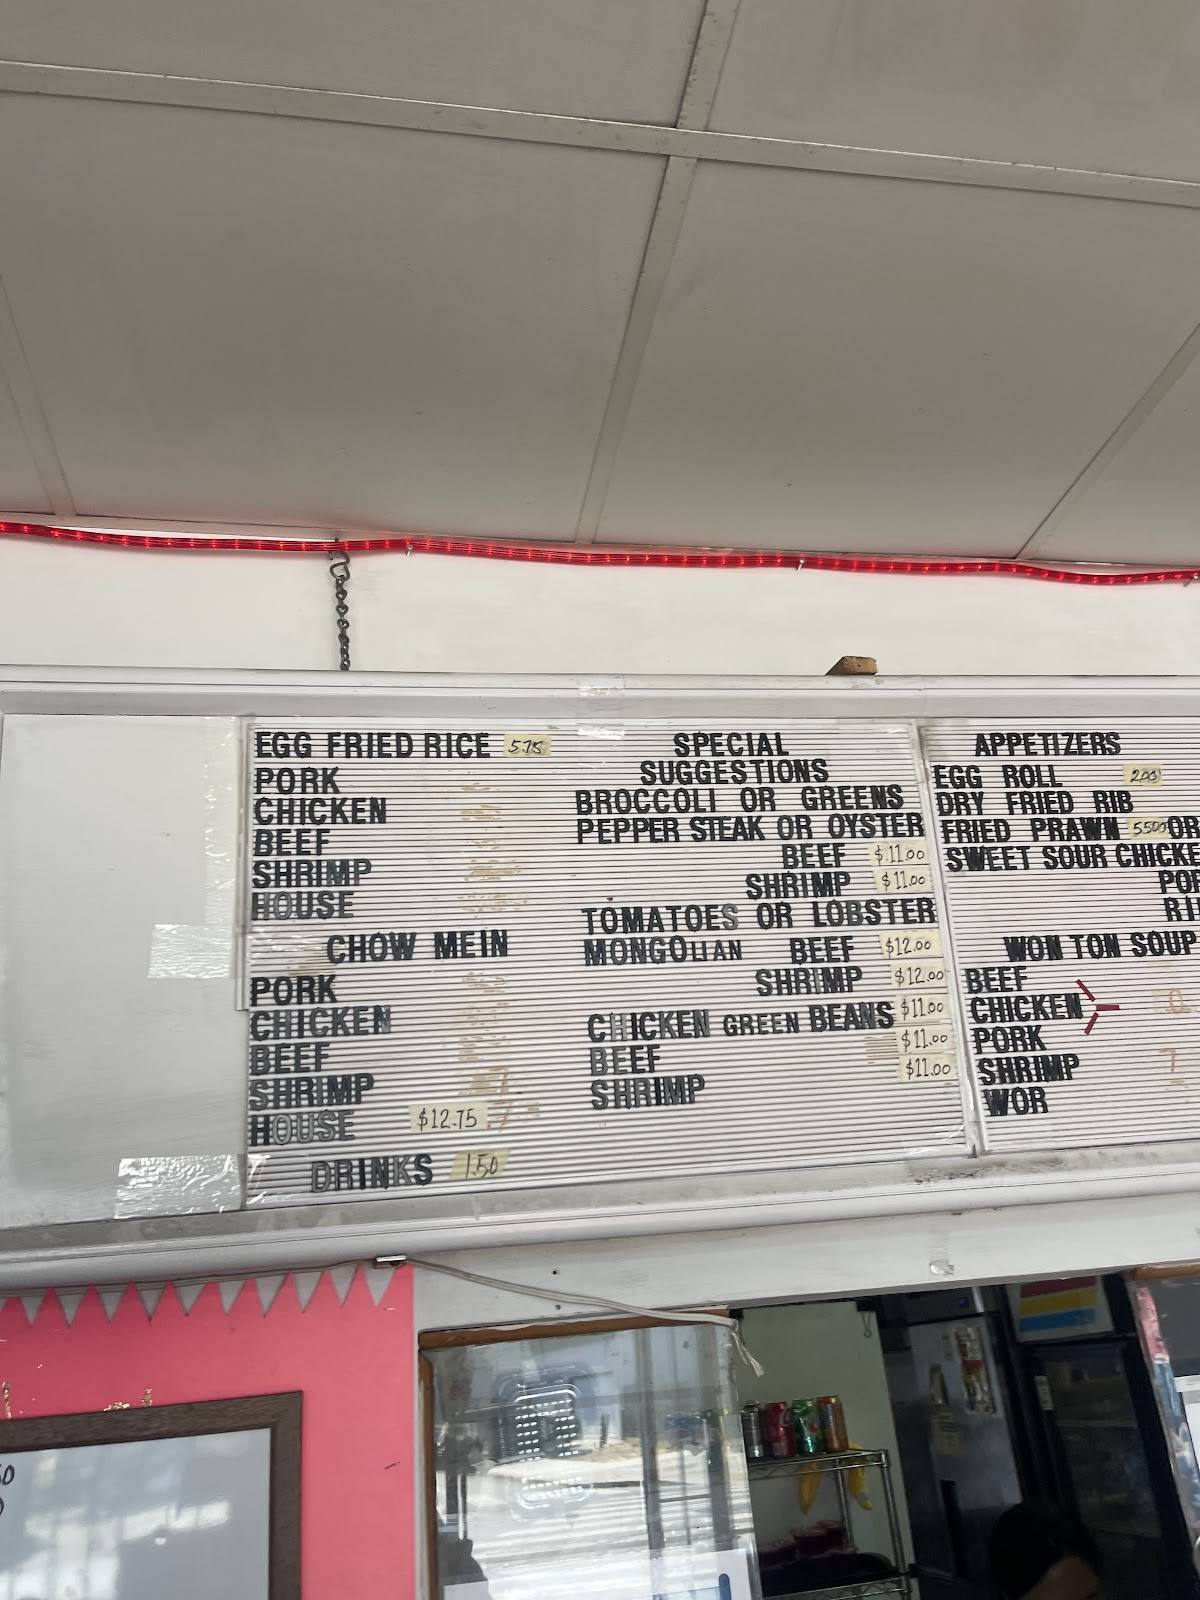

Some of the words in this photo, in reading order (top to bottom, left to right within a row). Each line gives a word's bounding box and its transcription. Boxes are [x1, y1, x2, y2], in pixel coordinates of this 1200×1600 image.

[256, 732, 312, 758] EGG
[327, 732, 413, 758] FRIED
[424, 732, 491, 758] RICE
[674, 732, 789, 758] SPECIAL
[975, 732, 1121, 756] APPETIZERS
[254, 767, 341, 794] PORK
[640, 758, 829, 786] SUGGESTIONS
[933, 764, 983, 789] EGG
[1002, 764, 1063, 788] ROLL
[253, 798, 387, 825] CHICKEN
[575, 788, 716, 815] BROCCOLI
[740, 787, 776, 813] OR
[801, 784, 904, 811] GREENS
[935, 791, 984, 816] DRY
[1005, 790, 1074, 815] FRIED
[1091, 790, 1134, 813] RIB
[253, 829, 330, 856] BEEF
[577, 817, 680, 844] PEPPER
[689, 815, 766, 842] STEAK
[777, 814, 812, 840] OR
[828, 812, 925, 839] OYSTER
[940, 818, 1010, 844] FRIED
[1029, 816, 1120, 842] PRAWN
[1168, 816, 1200, 839] OR
[782, 843, 846, 869] BEEF
[946, 845, 1030, 872] SWEET
[1042, 844, 1108, 870] SOUR
[252, 859, 372, 888] SHRIMP
[746, 872, 851, 900] SHRIMP
[252, 891, 354, 920] HOUSE
[582, 903, 739, 935] TOMATOES
[757, 901, 793, 930] OR
[812, 898, 937, 927] LOBSTER
[327, 932, 416, 963] CHOW
[434, 930, 508, 960] MEIN
[584, 935, 743, 966] MONGOLIAN
[789, 936, 854, 965] BEEF
[1003, 934, 1064, 962] WON
[1070, 932, 1121, 959] TON
[1130, 930, 1197, 958] SOUP
[250, 975, 338, 1006] PORK
[755, 966, 863, 996] SHRIMP
[965, 965, 1028, 994] BEEF
[588, 1009, 711, 1042] CHICKEN
[723, 1012, 801, 1036] GREEN
[808, 1001, 895, 1032] BEANS
[970, 992, 1083, 1024] CHICKEN
[250, 1005, 391, 1041] CHICKEN
[973, 1025, 1047, 1054] PORK
[250, 1043, 330, 1075] BEEF
[590, 1044, 661, 1076] BEEF
[978, 1053, 1080, 1085] SHRIMP
[249, 1073, 375, 1110] SHRIMP
[590, 1074, 706, 1110] SHRIMP
[983, 1086, 1049, 1116] WOR
[250, 1109, 355, 1146] HOUSE
[418, 1107, 478, 1131] $12.75
[311, 1154, 433, 1192] DRINKS
[465, 1152, 498, 1178] 1.50
